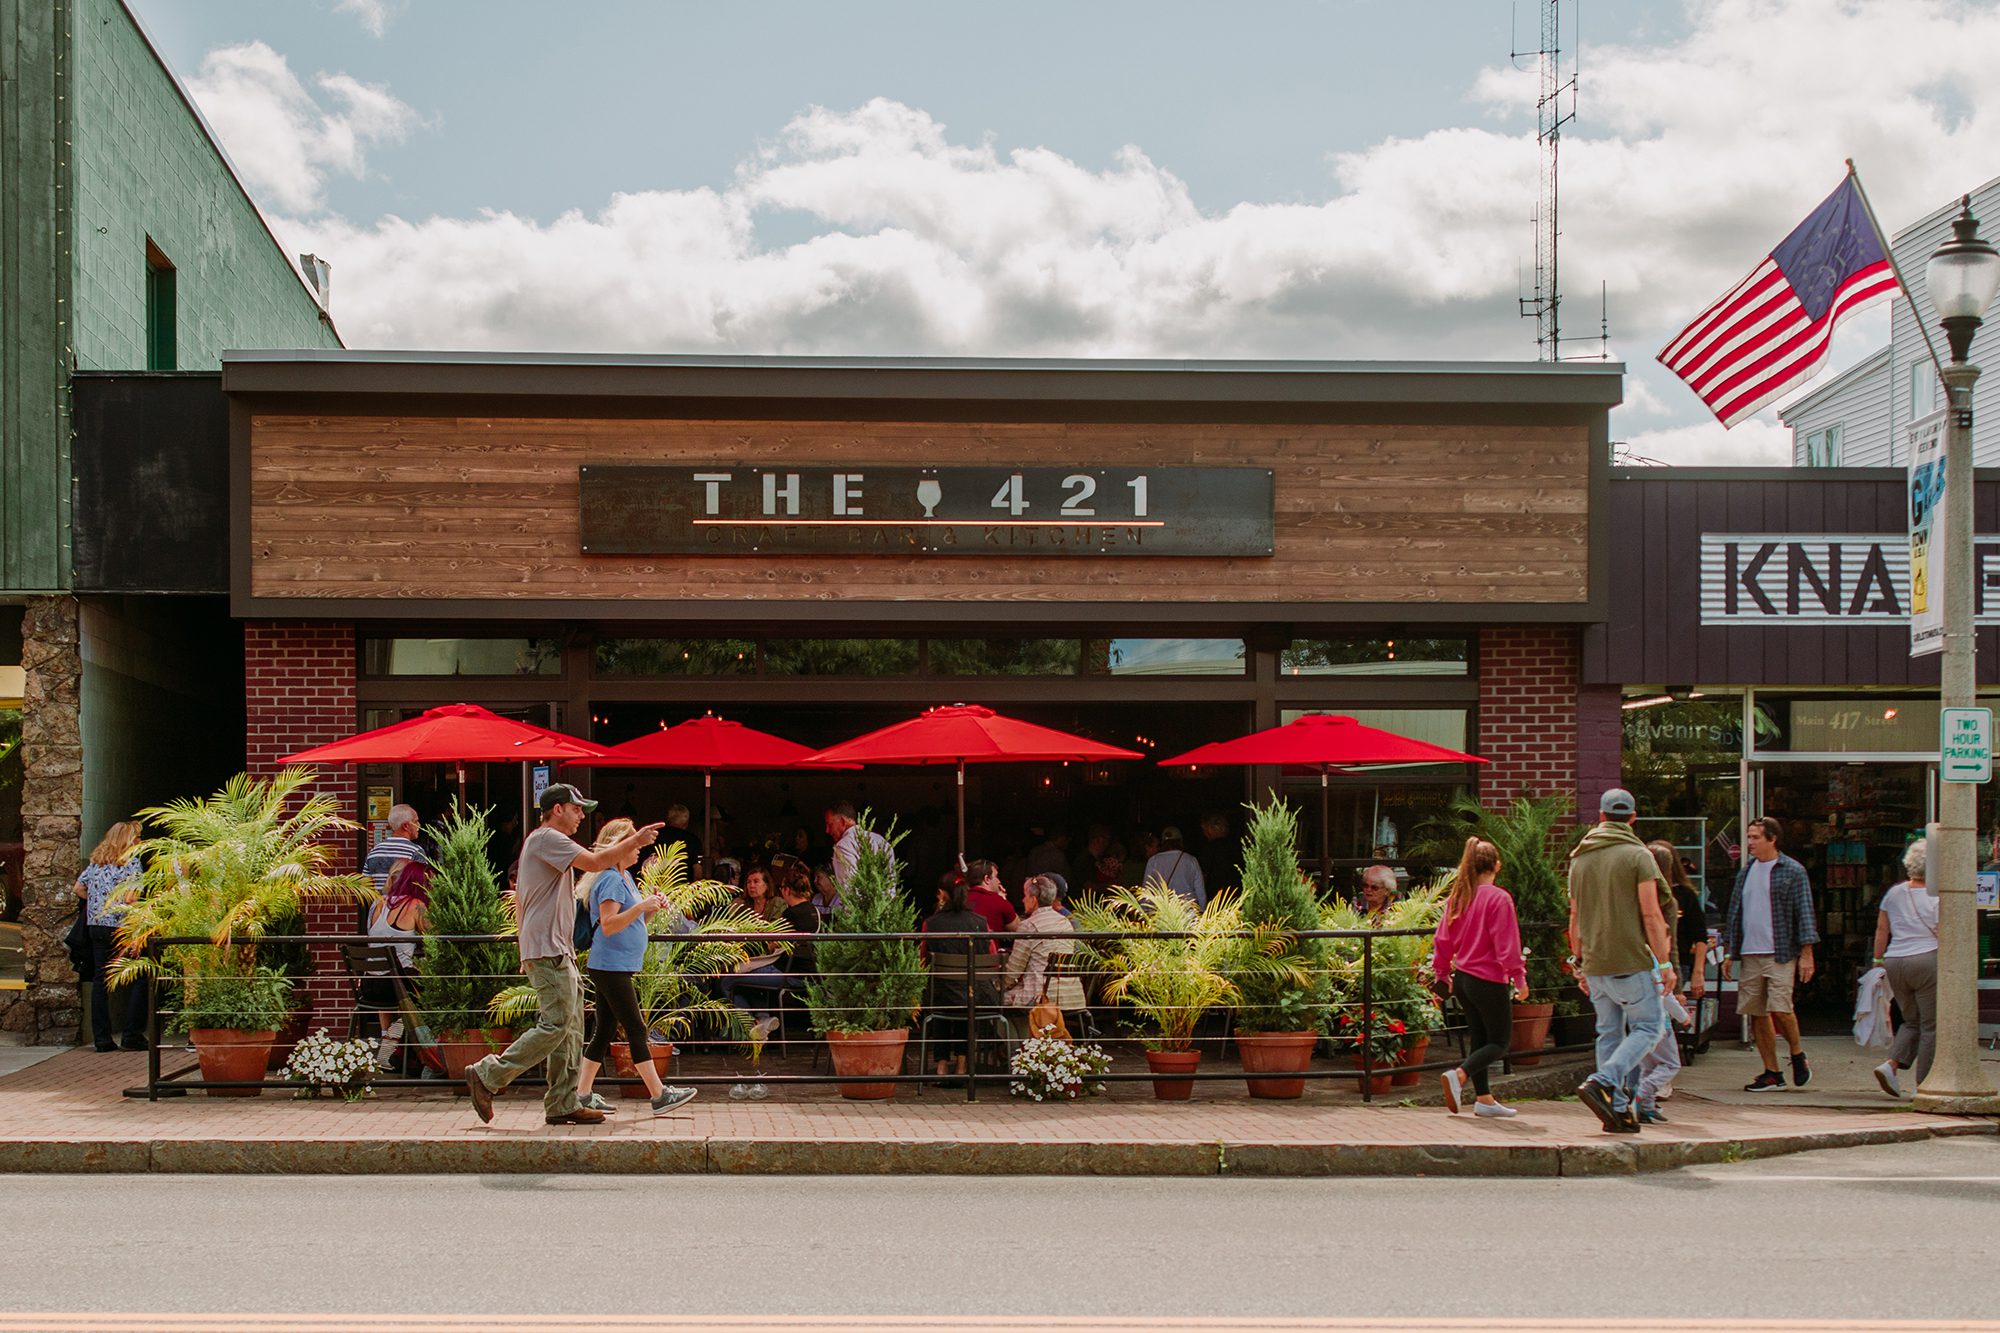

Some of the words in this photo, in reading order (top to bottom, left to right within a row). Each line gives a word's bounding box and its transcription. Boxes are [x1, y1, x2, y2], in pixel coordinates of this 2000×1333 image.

[694, 473, 864, 515] THE
[991, 475, 1147, 516] 421
[706, 526, 822, 545] CRAFT
[849, 526, 917, 545] BAR
[943, 527, 957, 545] &
[984, 526, 1143, 546] KITCHEN
[1725, 543, 2000, 615] KNA
[1796, 716, 1824, 726] Main
[1829, 711, 1861, 730] 417
[1955, 719, 1978, 731] TWO
[1952, 733, 1981, 745] HOUR
[1945, 747, 1988, 760] PARKING
